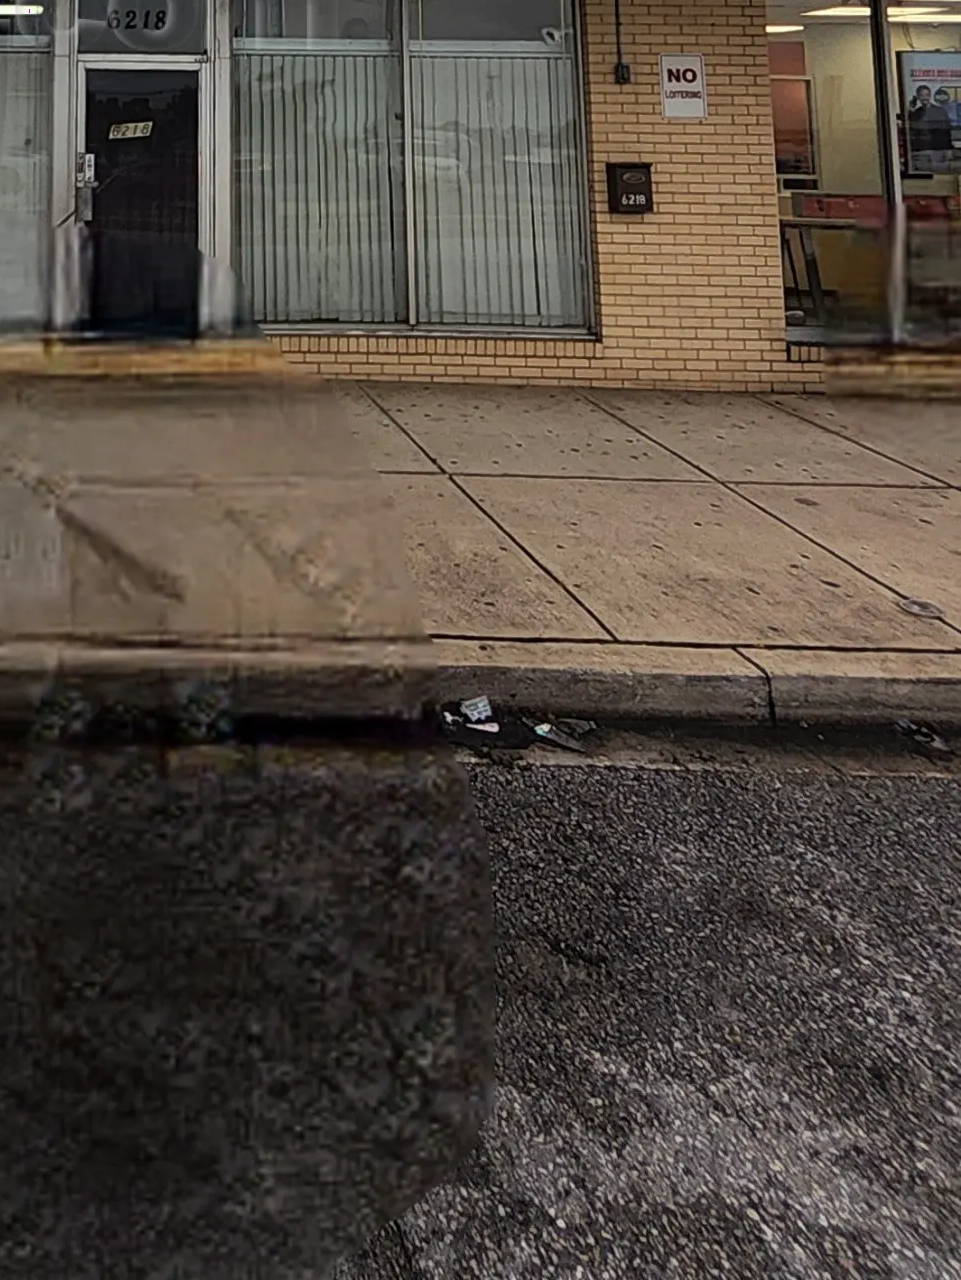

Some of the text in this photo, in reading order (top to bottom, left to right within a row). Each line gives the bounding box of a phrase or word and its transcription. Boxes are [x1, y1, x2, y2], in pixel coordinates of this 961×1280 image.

[107, 9, 167, 31] 6218
[667, 68, 698, 84] NO
[664, 90, 702, 100] LOITERING
[111, 123, 151, 137] 6218
[621, 193, 647, 206] 6218
